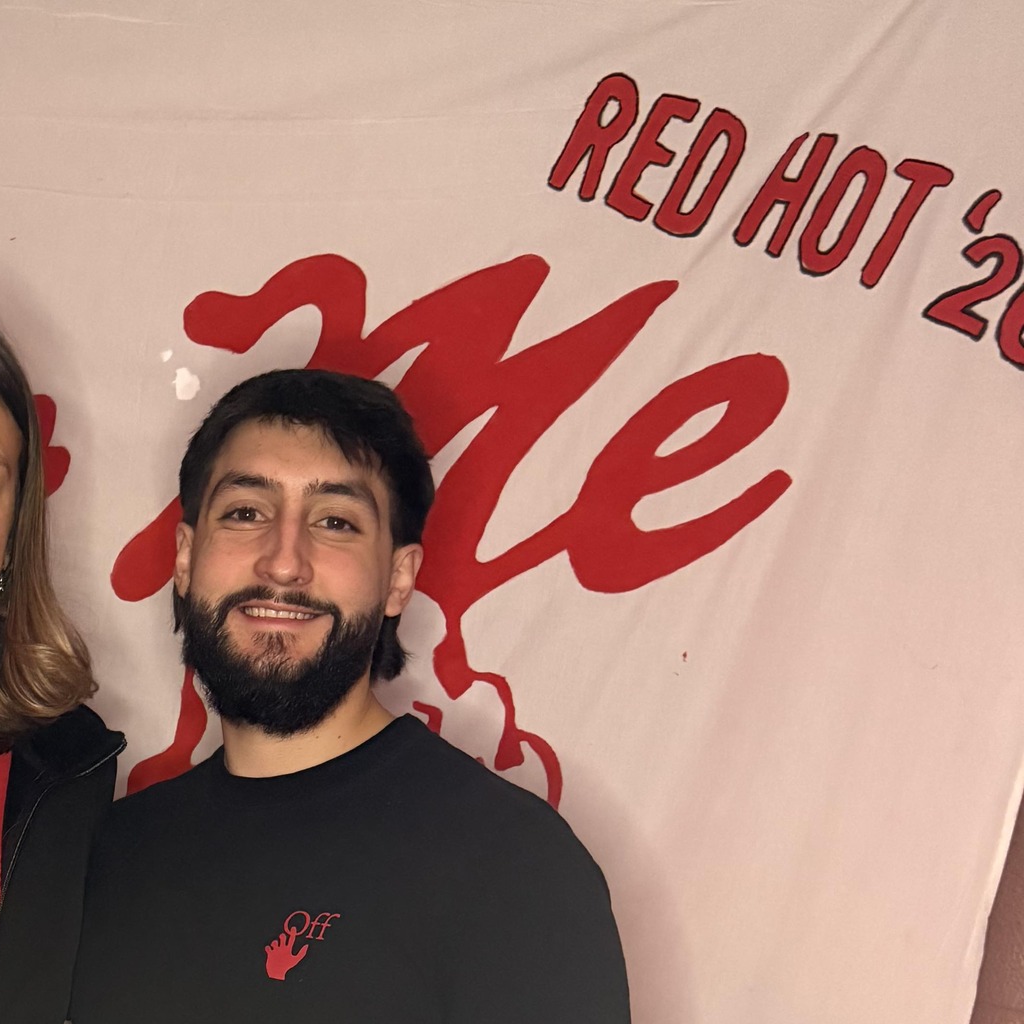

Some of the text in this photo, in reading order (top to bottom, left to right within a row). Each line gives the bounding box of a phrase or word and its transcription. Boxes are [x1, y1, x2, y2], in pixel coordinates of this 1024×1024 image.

[547, 72, 747, 237] RED
[733, 131, 954, 289] HOT
[110, 253, 793, 602] Me
[283, 910, 341, 940] Off
